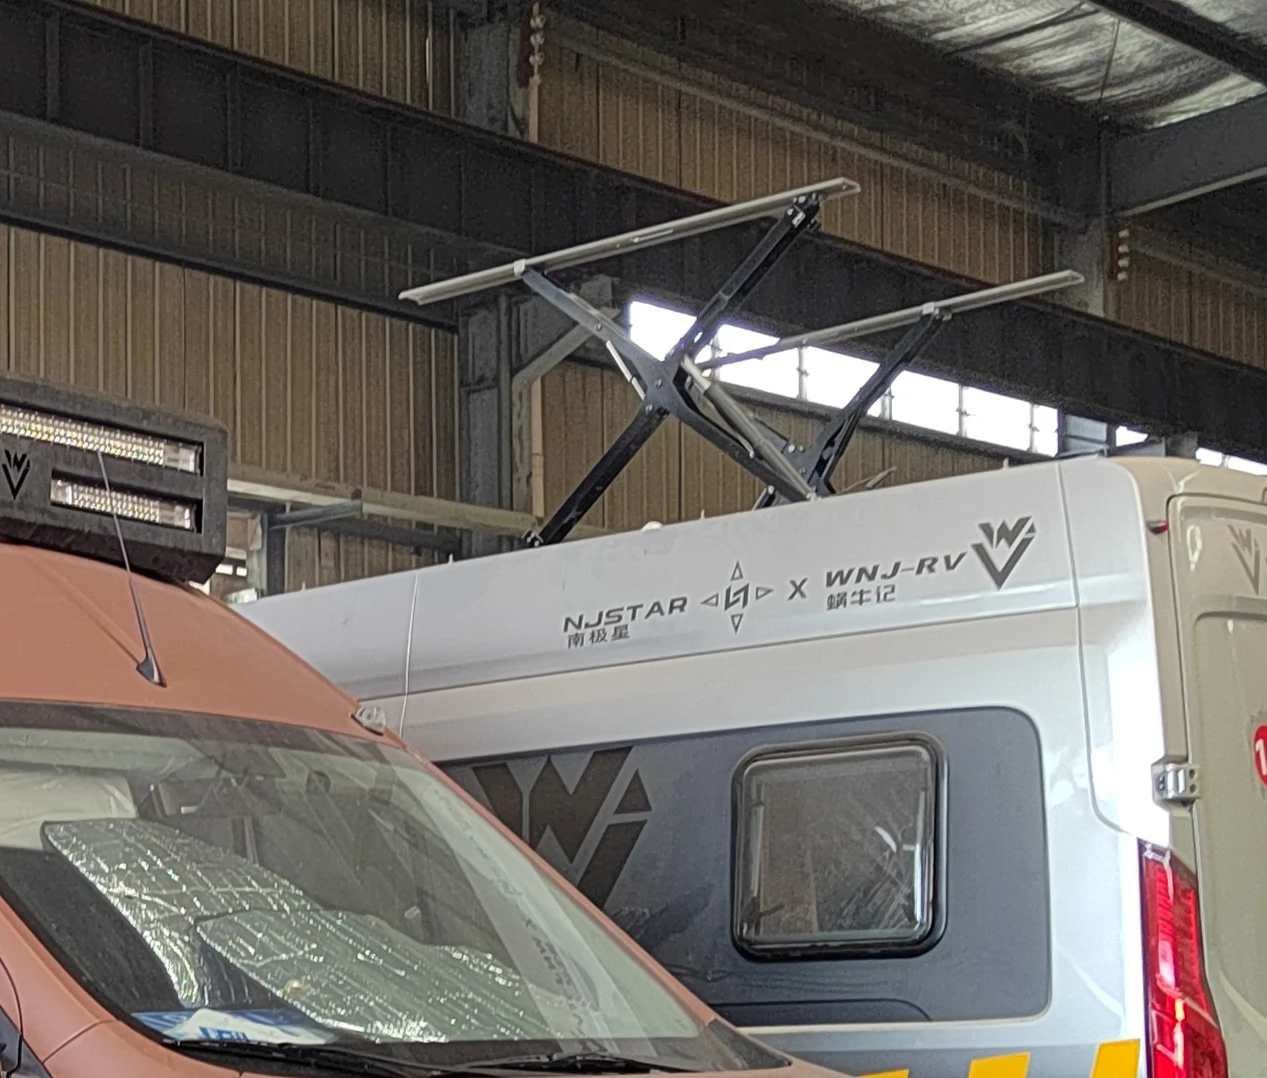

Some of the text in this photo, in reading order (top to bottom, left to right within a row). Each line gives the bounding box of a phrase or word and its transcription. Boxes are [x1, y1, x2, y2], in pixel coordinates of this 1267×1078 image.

[563, 552, 967, 632] NJSTAR X WNJ-RV
[567, 623, 630, 649] 南极星
